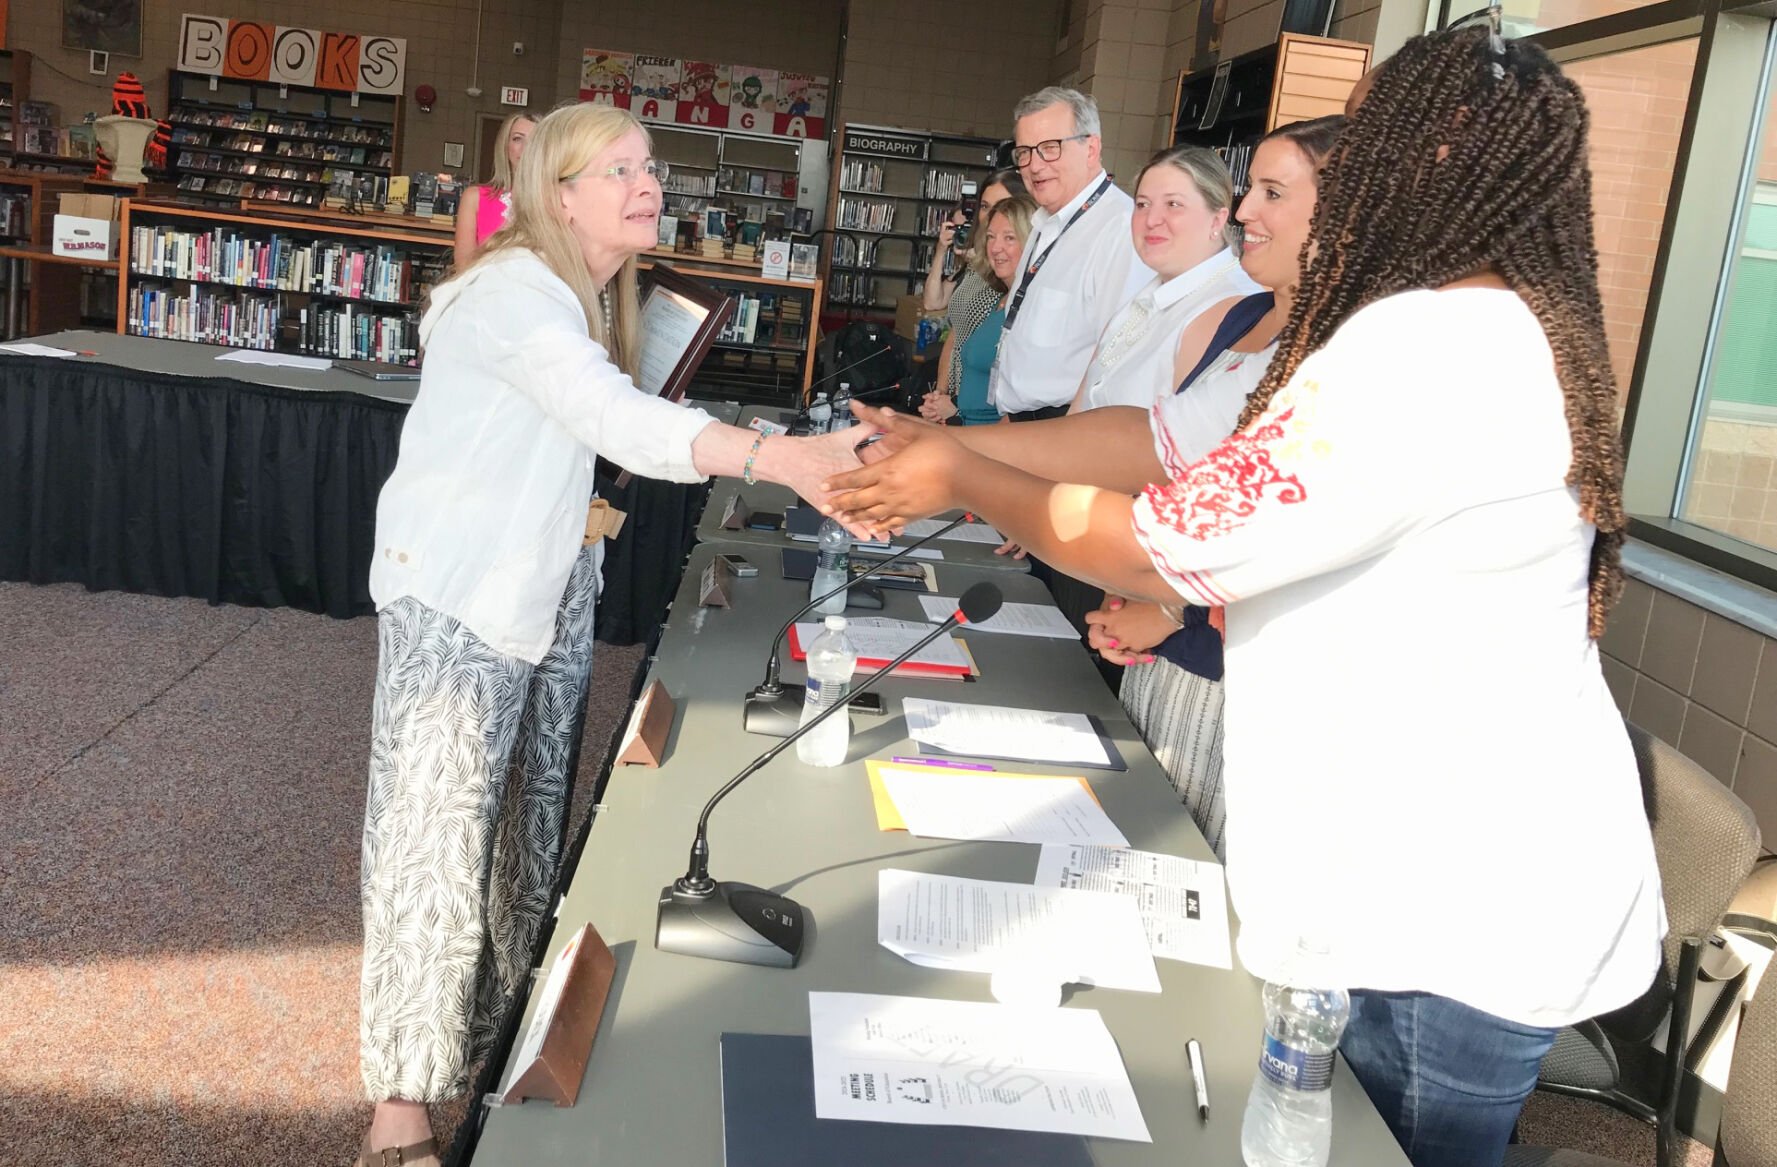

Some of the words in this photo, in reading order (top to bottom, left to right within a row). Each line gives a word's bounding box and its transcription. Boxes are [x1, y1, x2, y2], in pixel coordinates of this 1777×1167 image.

[183, 17, 399, 89] BOOKS
[506, 89, 525, 104] EXIT
[849, 137, 918, 154] BIOGRAPHY
[1263, 1050, 1298, 1075] rvana
[849, 1073, 862, 1100] MEETING
[863, 1073, 877, 1102] SCHEDULE
